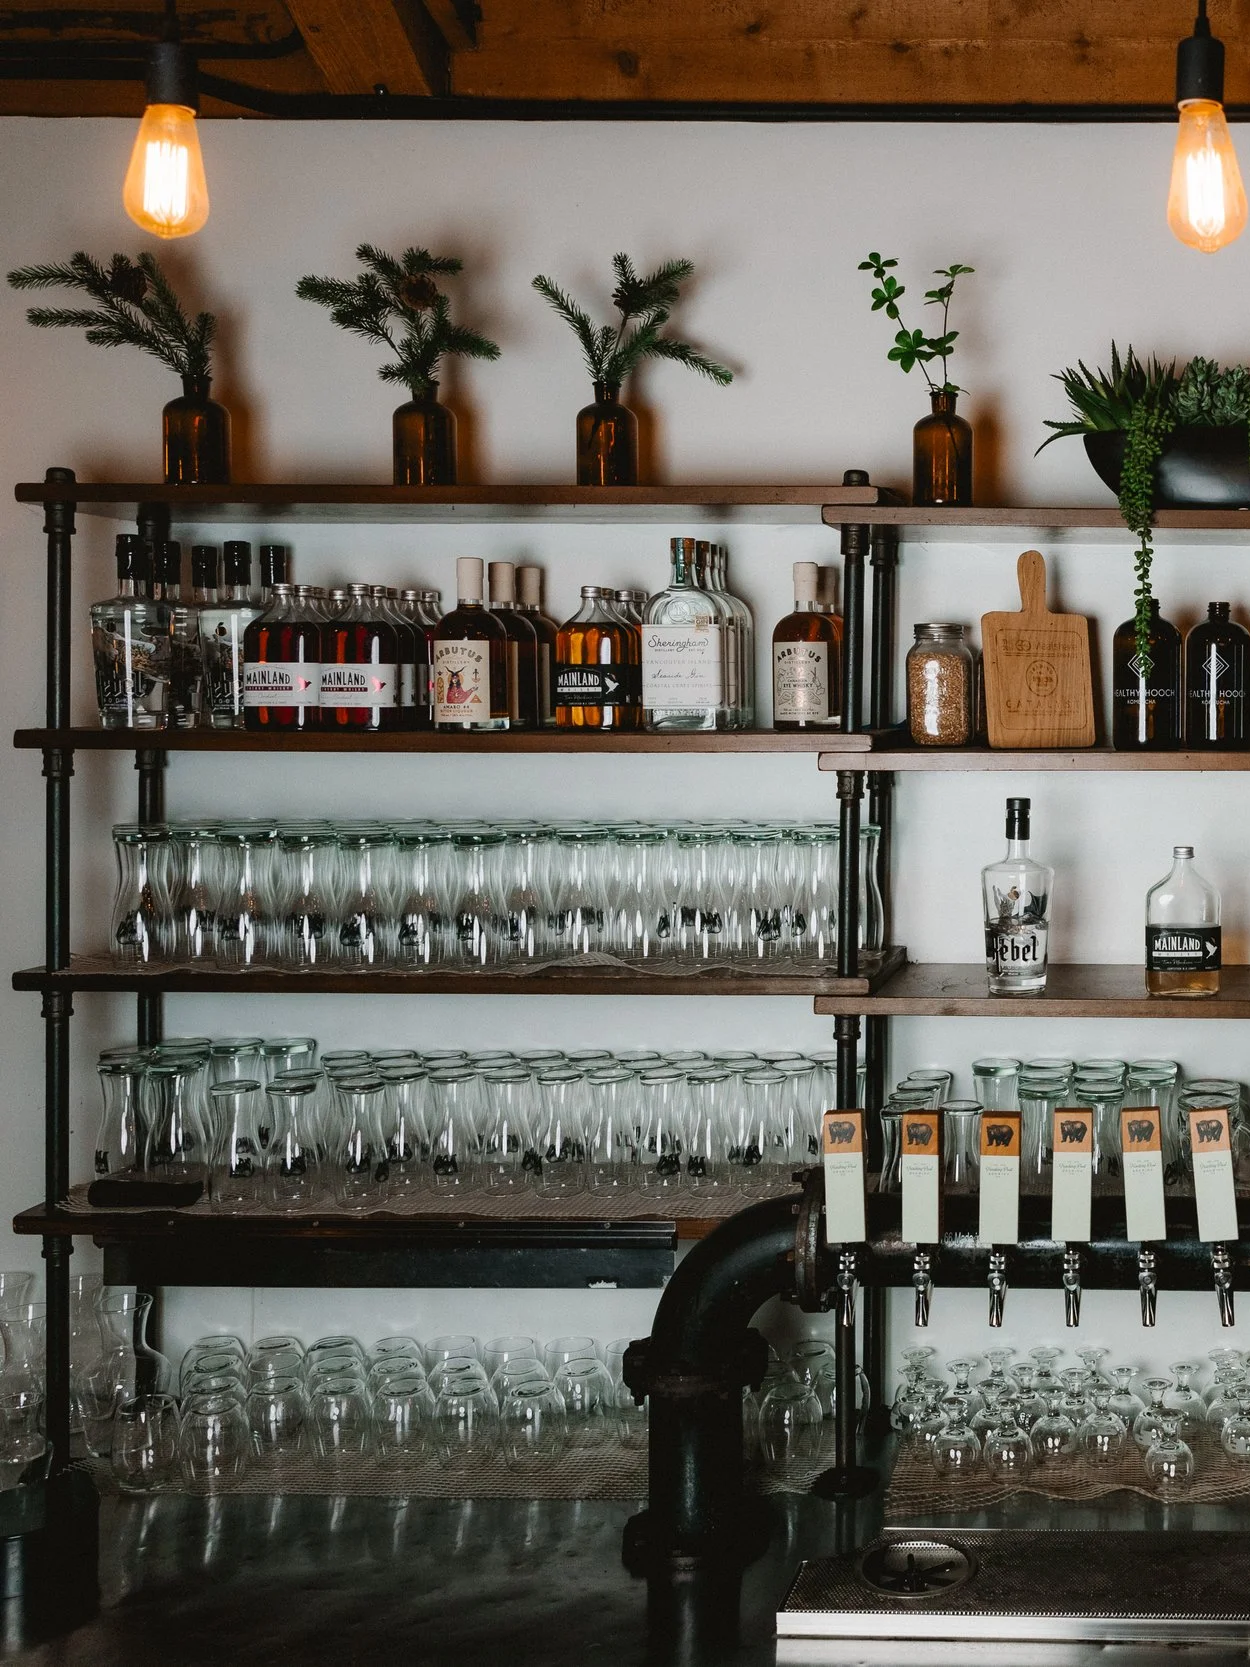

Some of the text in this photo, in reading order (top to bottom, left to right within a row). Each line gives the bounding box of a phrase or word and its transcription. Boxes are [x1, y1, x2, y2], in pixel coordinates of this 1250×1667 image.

[647, 634, 709, 653] Sheringham
[435, 646, 483, 663] ARBUTUS
[777, 647, 822, 663] ARBUTUS
[246, 670, 291, 685] MAINLAND
[321, 671, 366, 686] MAINLAND
[558, 671, 600, 686] MAINLAND
[1145, 688, 1176, 697] HOOCH
[1219, 689, 1246, 698] HOOC
[1154, 936, 1201, 951] MAINLAND
